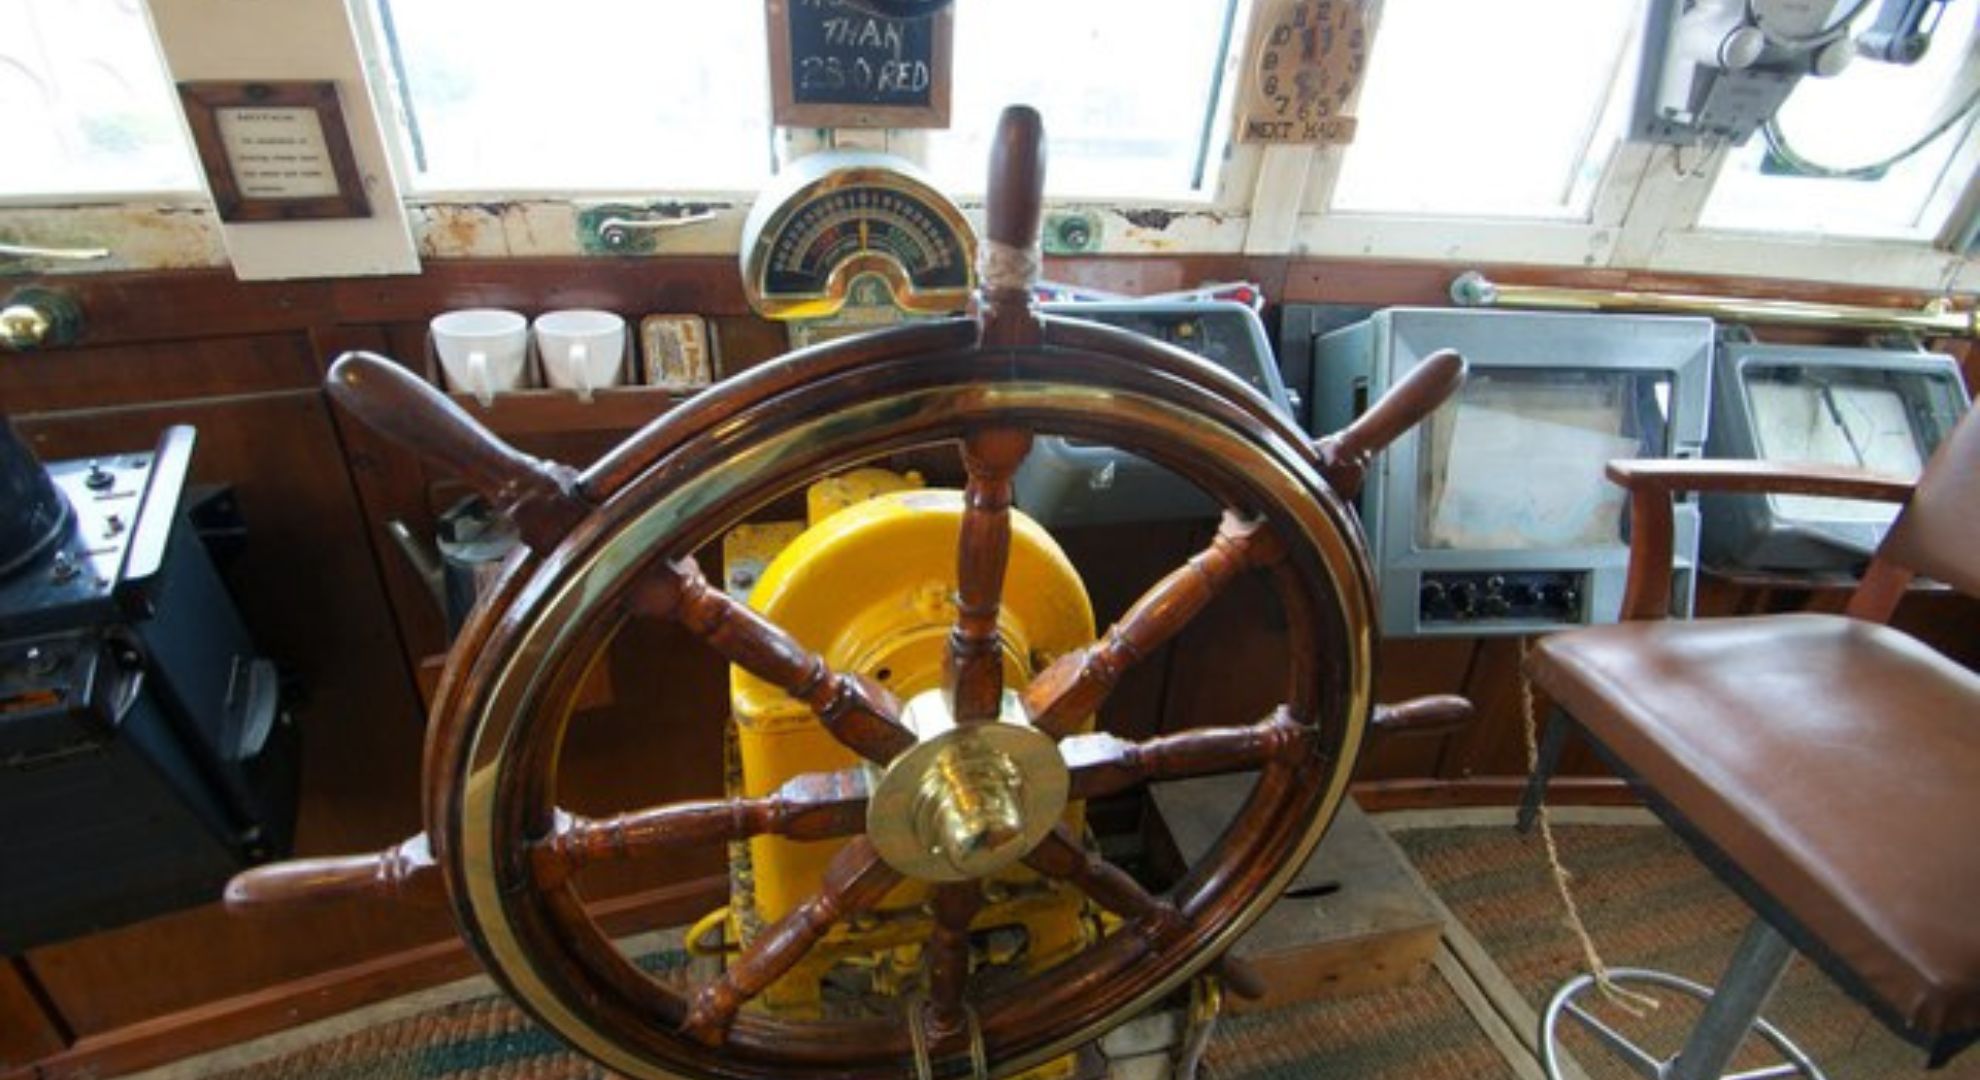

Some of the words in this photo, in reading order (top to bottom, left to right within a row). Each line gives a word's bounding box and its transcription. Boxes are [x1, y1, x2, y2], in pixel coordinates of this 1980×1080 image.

[822, 18, 904, 56] THAN
[877, 59, 929, 92] RED
[1274, 96, 1290, 115] 7
[1246, 120, 1294, 139] NEXT
[1301, 120, 1345, 140] HAU
